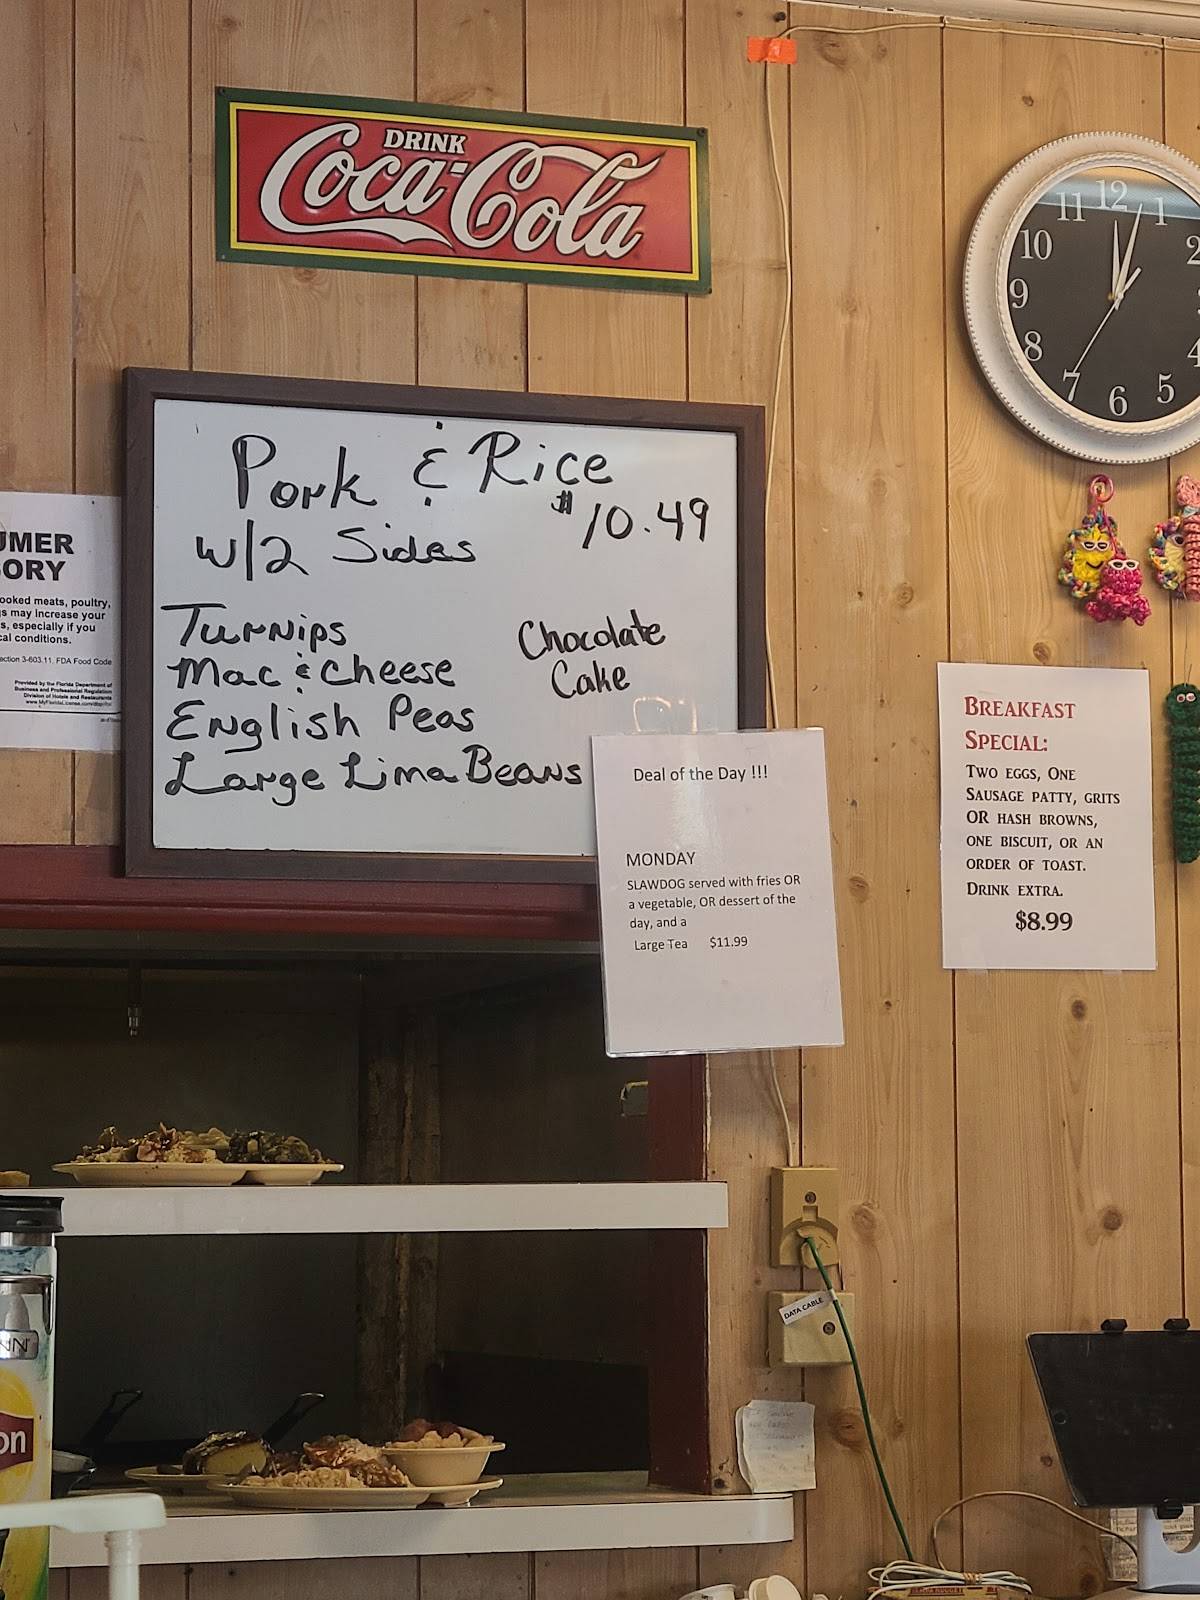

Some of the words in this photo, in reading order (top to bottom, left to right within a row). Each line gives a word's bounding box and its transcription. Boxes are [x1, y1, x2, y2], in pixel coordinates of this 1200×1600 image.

[384, 129, 468, 155] DRINK
[260, 122, 668, 259] Coca-Cola
[1096, 179, 1129, 212] 12
[1056, 192, 1087, 222] 11
[1155, 197, 1169, 226] 1
[1019, 229, 1053, 260] 10
[1186, 235, 1200, 265] 2
[1009, 278, 1029, 309] 9
[1024, 330, 1043, 362] 8
[1063, 369, 1081, 401] 7
[1157, 373, 1175, 404] 5
[1108, 386, 1129, 417] 6
[232, 435, 377, 509] Pork
[468, 431, 613, 494] Rice
[333, 523, 476, 563] Sides
[0, 559, 65, 581] ORY
[11, 610, 31, 619] may
[36, 609, 78, 619] increase
[82, 613, 105, 621] your
[34, 598, 67, 607] meats,
[72, 598, 110, 609] poultry,
[13, 622, 63, 633] especially
[67, 623, 73, 631] if
[77, 625, 95, 633] you
[15, 634, 71, 644] conditions.
[519, 609, 665, 661] Chocolate
[55, 657, 72, 665] FDA
[73, 657, 93, 666] Food
[94, 658, 112, 666] Code
[167, 658, 281, 689] Mac
[552, 660, 630, 699] Cake
[390, 694, 474, 732] Peas
[165, 750, 325, 806] Large
[339, 752, 459, 790] Lima
[634, 767, 665, 781] Deal
[671, 767, 684, 781] of
[690, 767, 713, 780] the
[719, 767, 745, 782] Day
[752, 765, 767, 778] !!!
[967, 810, 989, 823] OR
[627, 852, 695, 866] MONDAY
[628, 879, 685, 890] SLAWDOG
[689, 877, 725, 888] served
[729, 876, 753, 887] with
[757, 876, 780, 886] fries
[784, 875, 800, 885] OR
[638, 897, 696, 911] vegetable,
[700, 897, 715, 907] OR
[719, 896, 759, 906] dessert
[763, 894, 774, 904] of
[777, 894, 795, 904] the
[630, 918, 652, 930] day,
[657, 916, 676, 927] and
[1016, 910, 1072, 931] $8.99
[635, 940, 664, 952] Large
[668, 939, 687, 949] Tea
[710, 937, 747, 949] $11.99
[783, 1306, 802, 1320] DATA
[802, 1297, 824, 1311] CABLE
